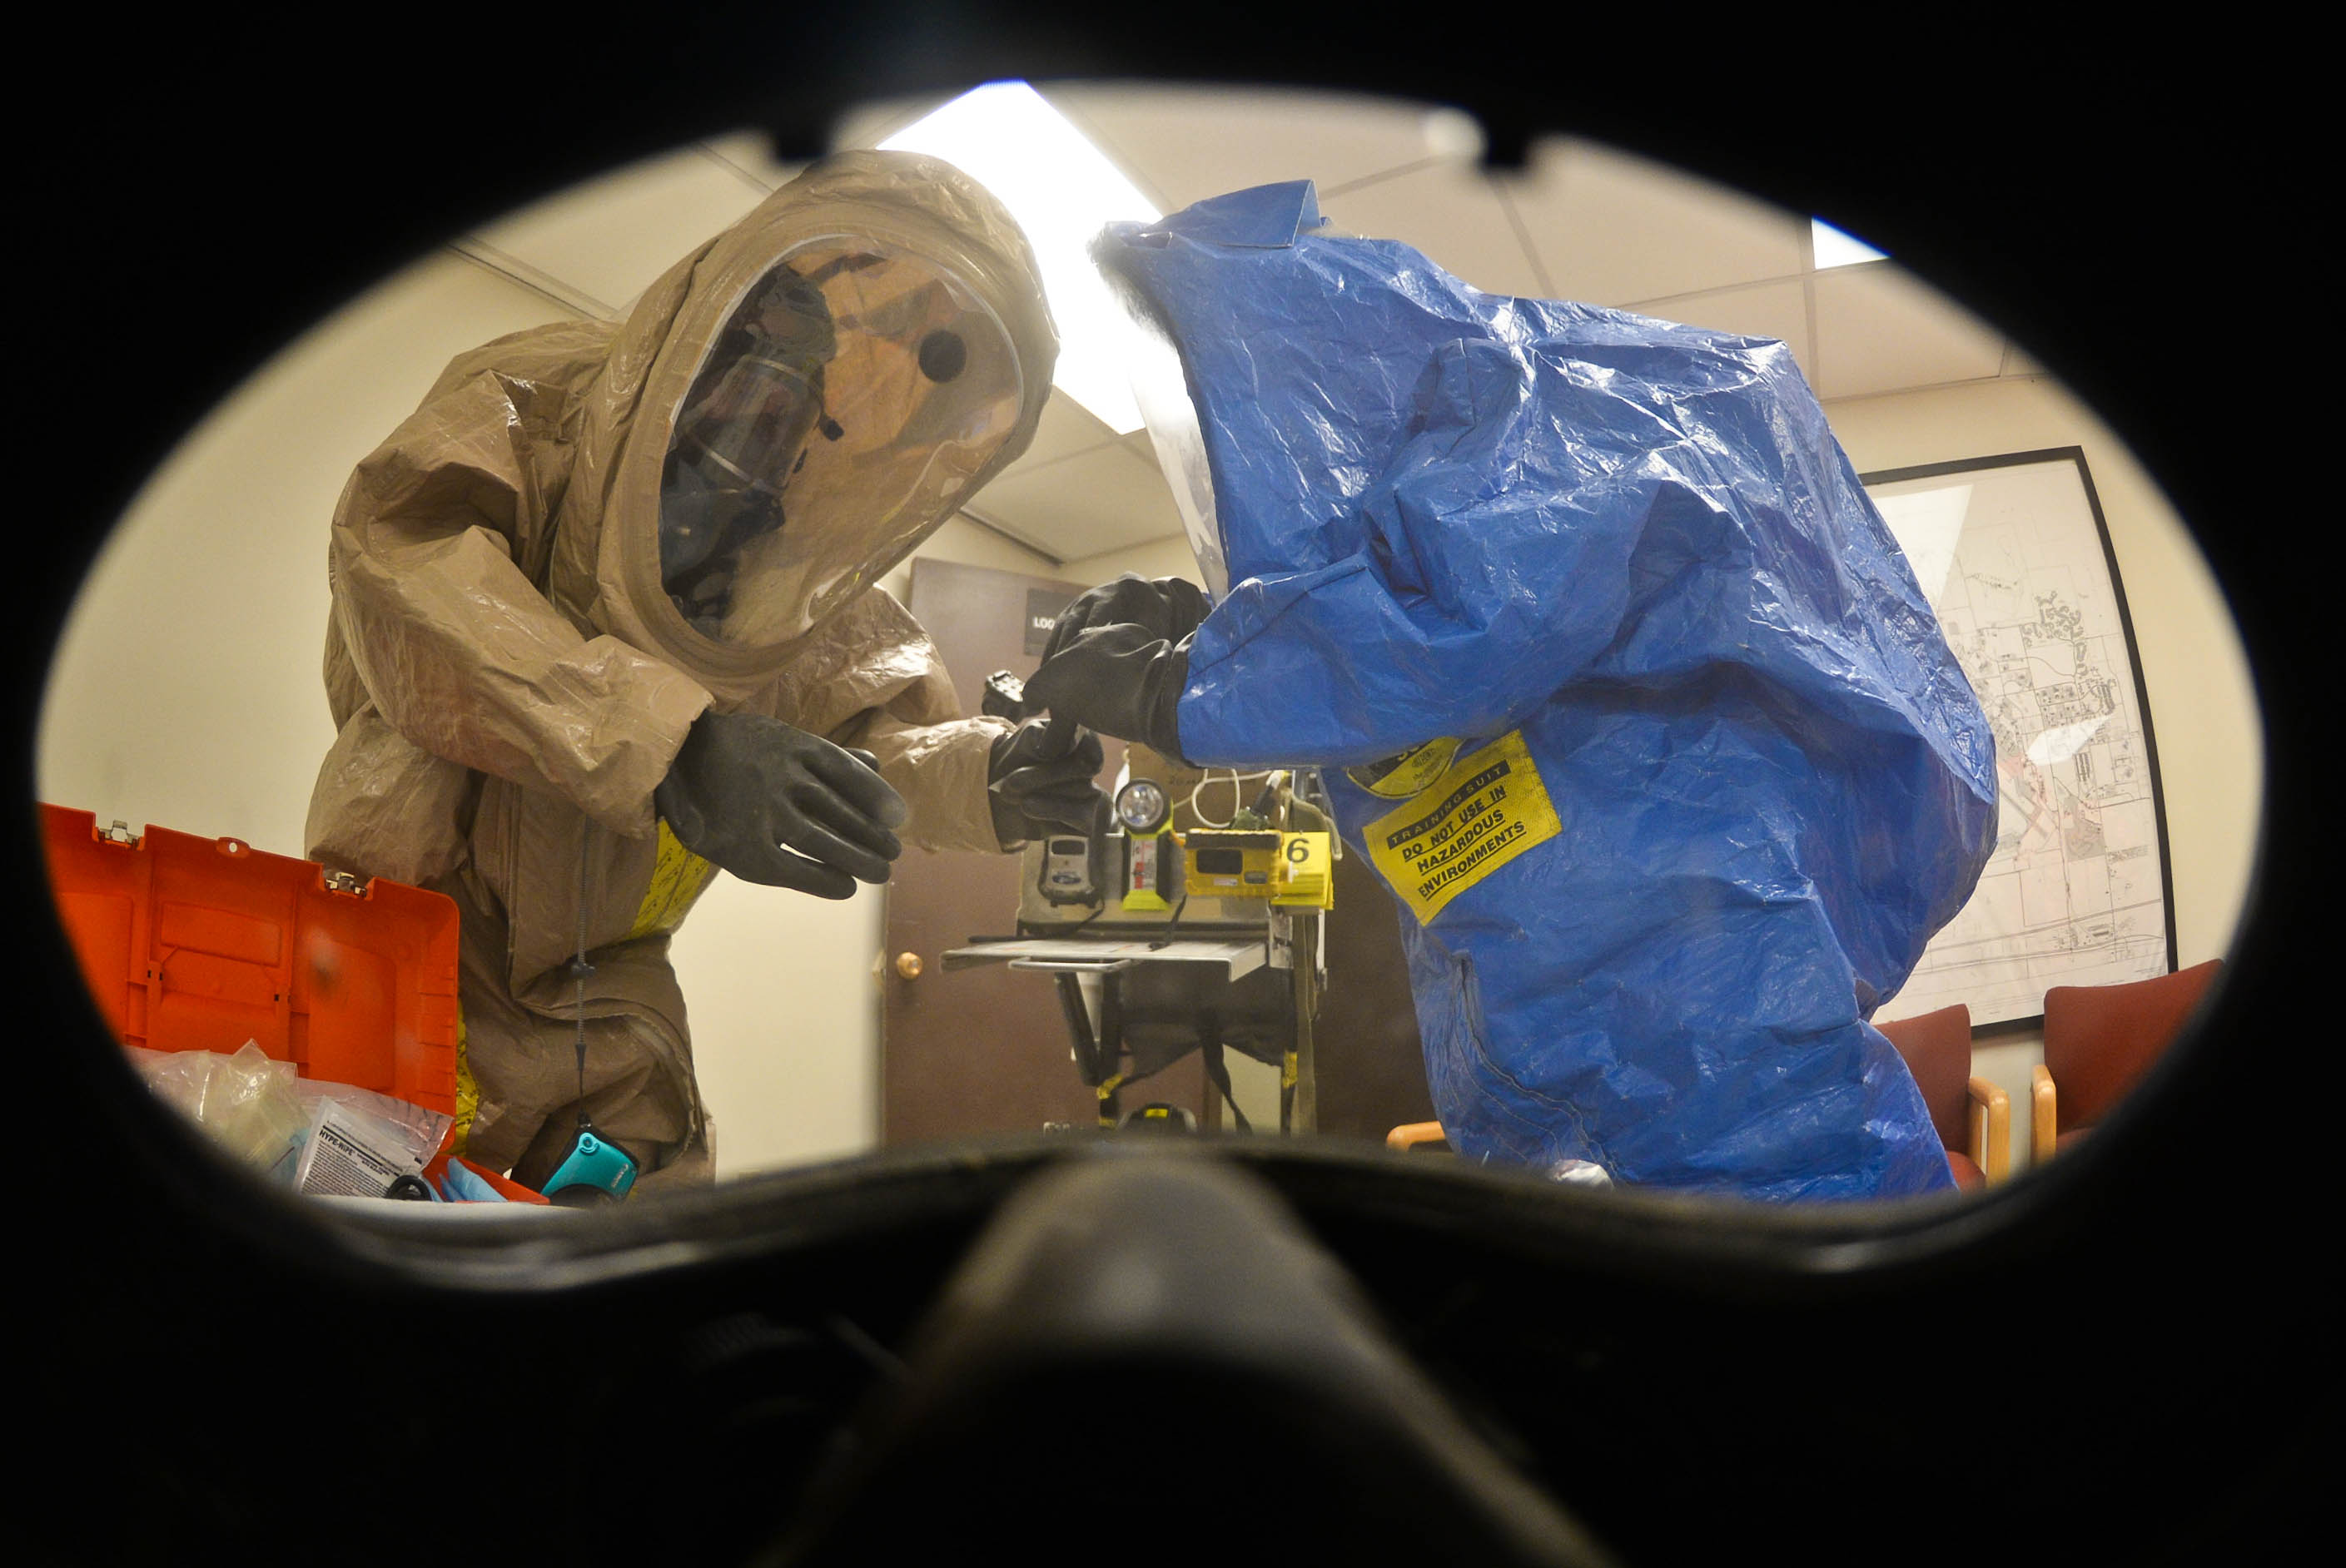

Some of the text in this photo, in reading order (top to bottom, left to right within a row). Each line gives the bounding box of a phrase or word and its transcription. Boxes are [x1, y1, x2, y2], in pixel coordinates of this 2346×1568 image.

[1392, 794, 1462, 844] TRAINING
[1466, 767, 1501, 793] SUIT
[1402, 785, 1506, 859] DO NOT USE IN
[1417, 809, 1504, 873] HAZARDOUS
[1286, 838, 1310, 863] 6
[1418, 821, 1525, 898] ENVIRONMENTS
